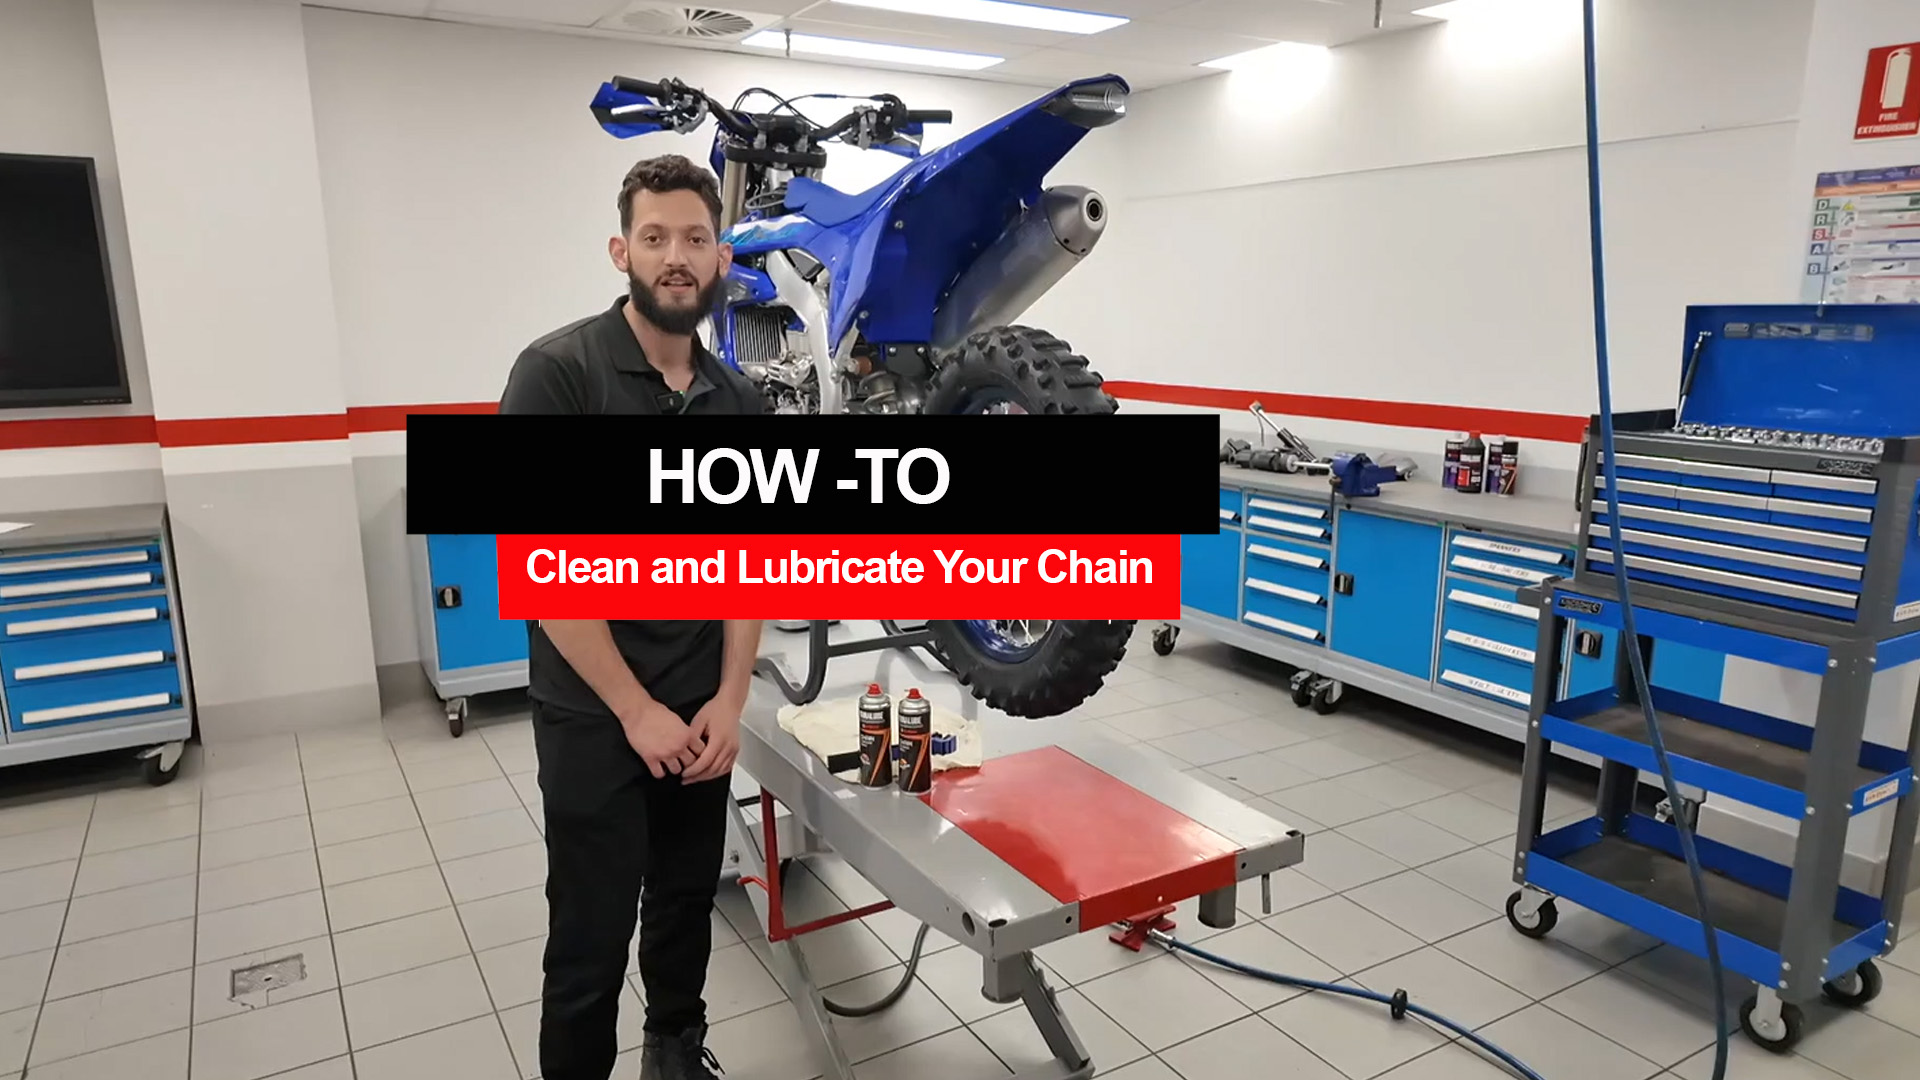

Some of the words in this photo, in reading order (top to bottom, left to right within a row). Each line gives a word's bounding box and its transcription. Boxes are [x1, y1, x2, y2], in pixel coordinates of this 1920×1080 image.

[1879, 112, 1898, 122] FIRE
[1819, 201, 1828, 209] D
[1816, 215, 1825, 223] R
[1814, 230, 1823, 238] S
